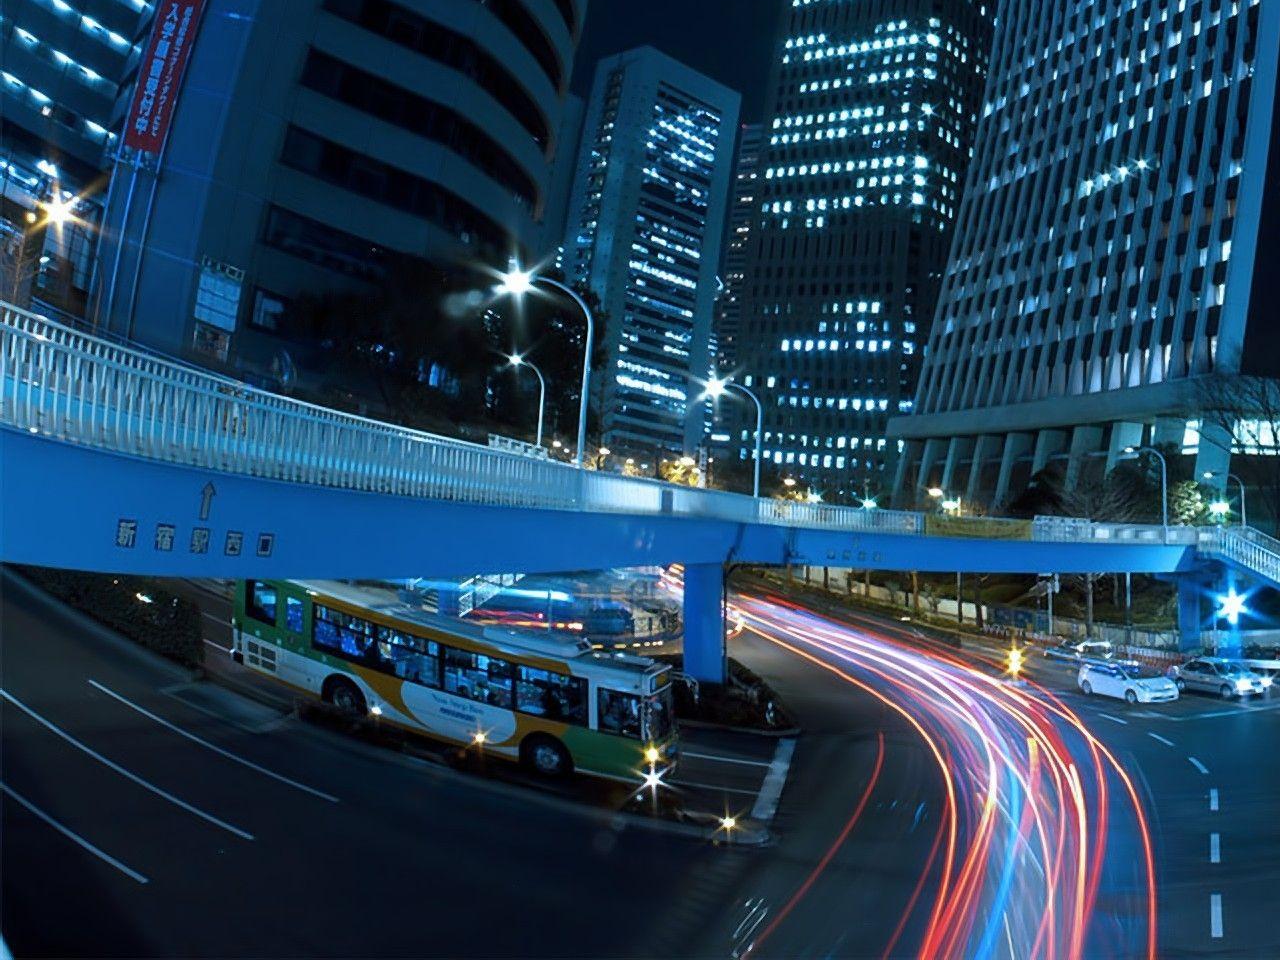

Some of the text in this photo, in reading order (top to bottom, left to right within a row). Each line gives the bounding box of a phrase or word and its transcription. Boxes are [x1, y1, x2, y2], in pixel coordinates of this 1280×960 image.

[116, 519, 276, 558] 新宿駅西口
